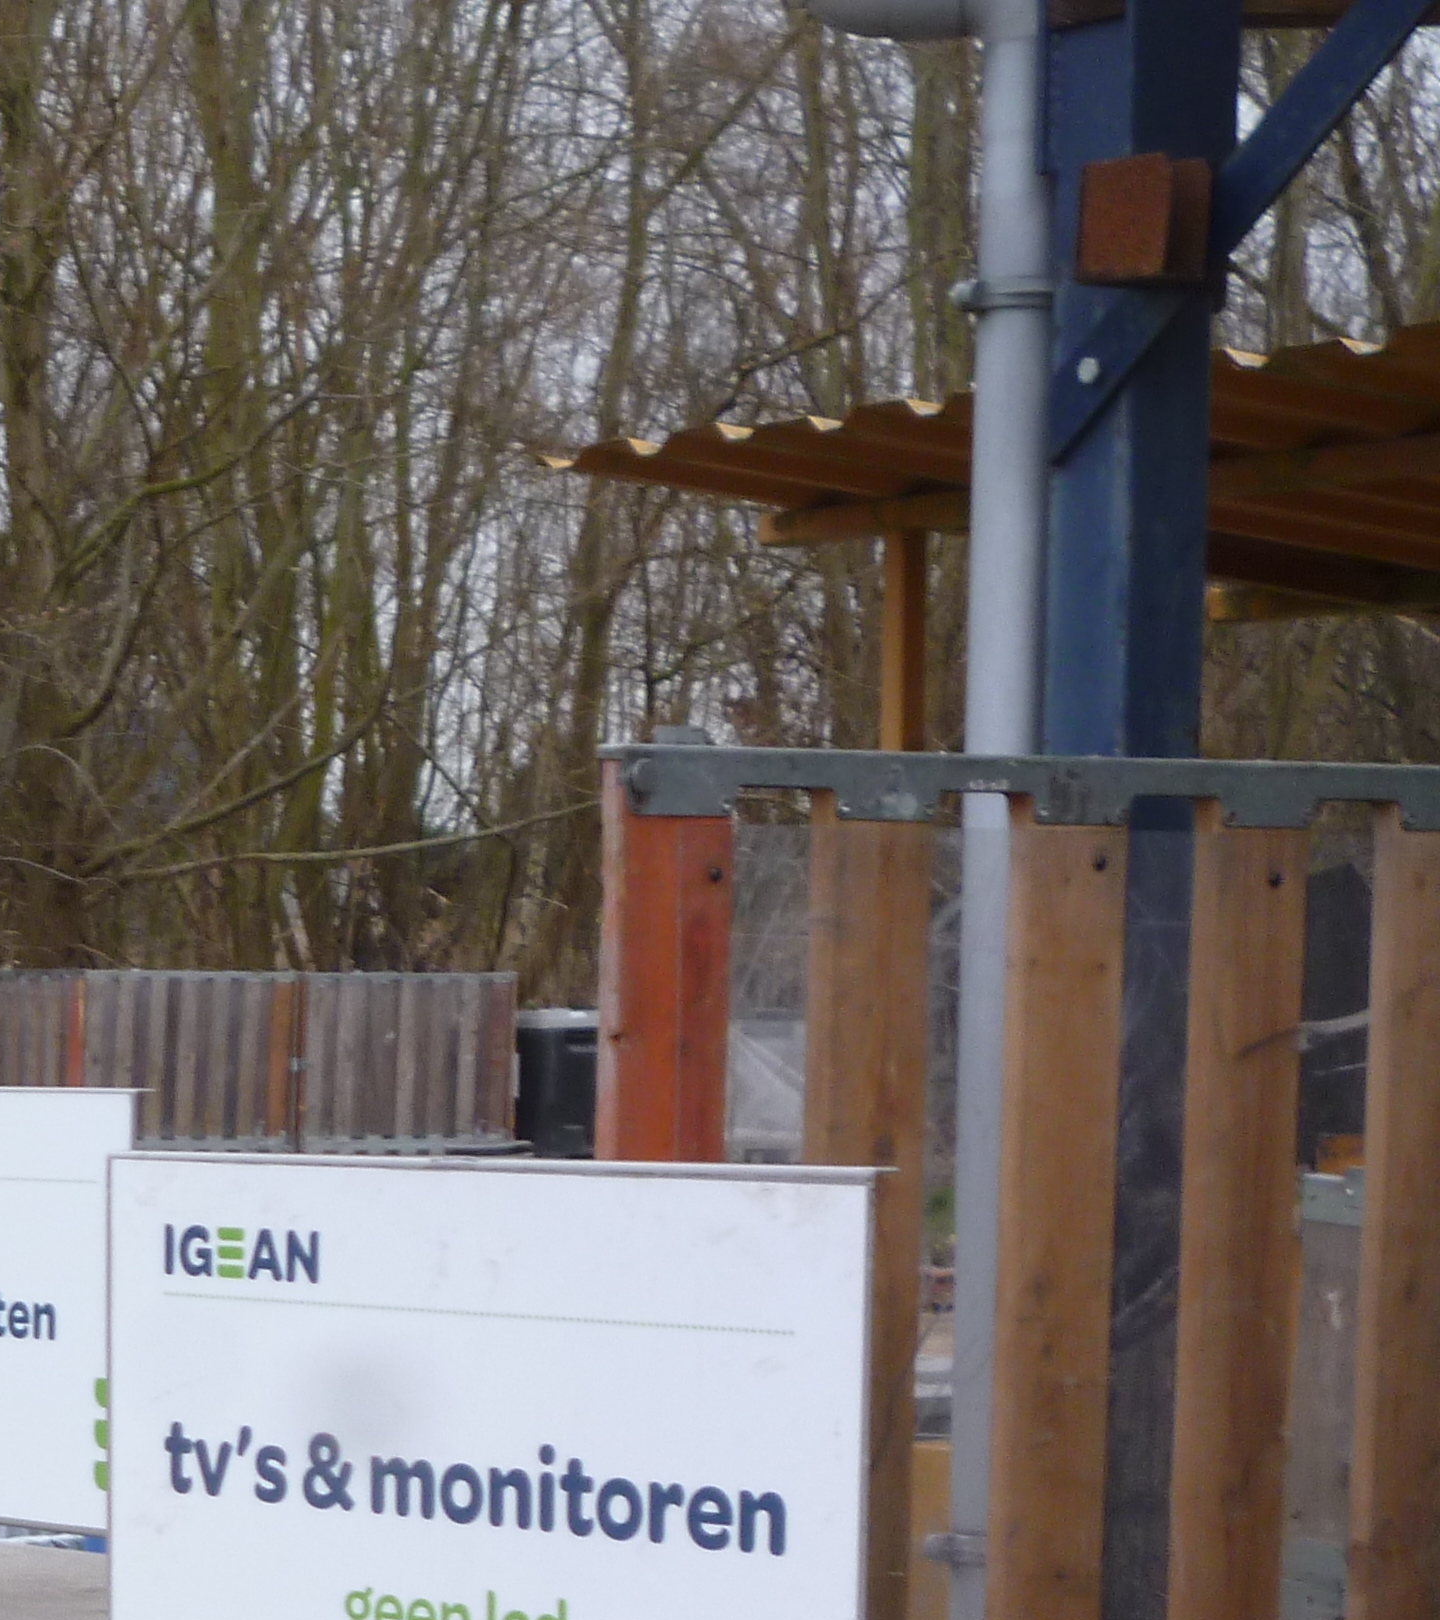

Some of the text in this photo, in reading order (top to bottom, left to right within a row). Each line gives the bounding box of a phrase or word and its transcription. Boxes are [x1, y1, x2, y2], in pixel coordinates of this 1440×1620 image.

[163, 1223, 321, 1284] IGEAN
[163, 1421, 788, 1558] tv's & monitoren
